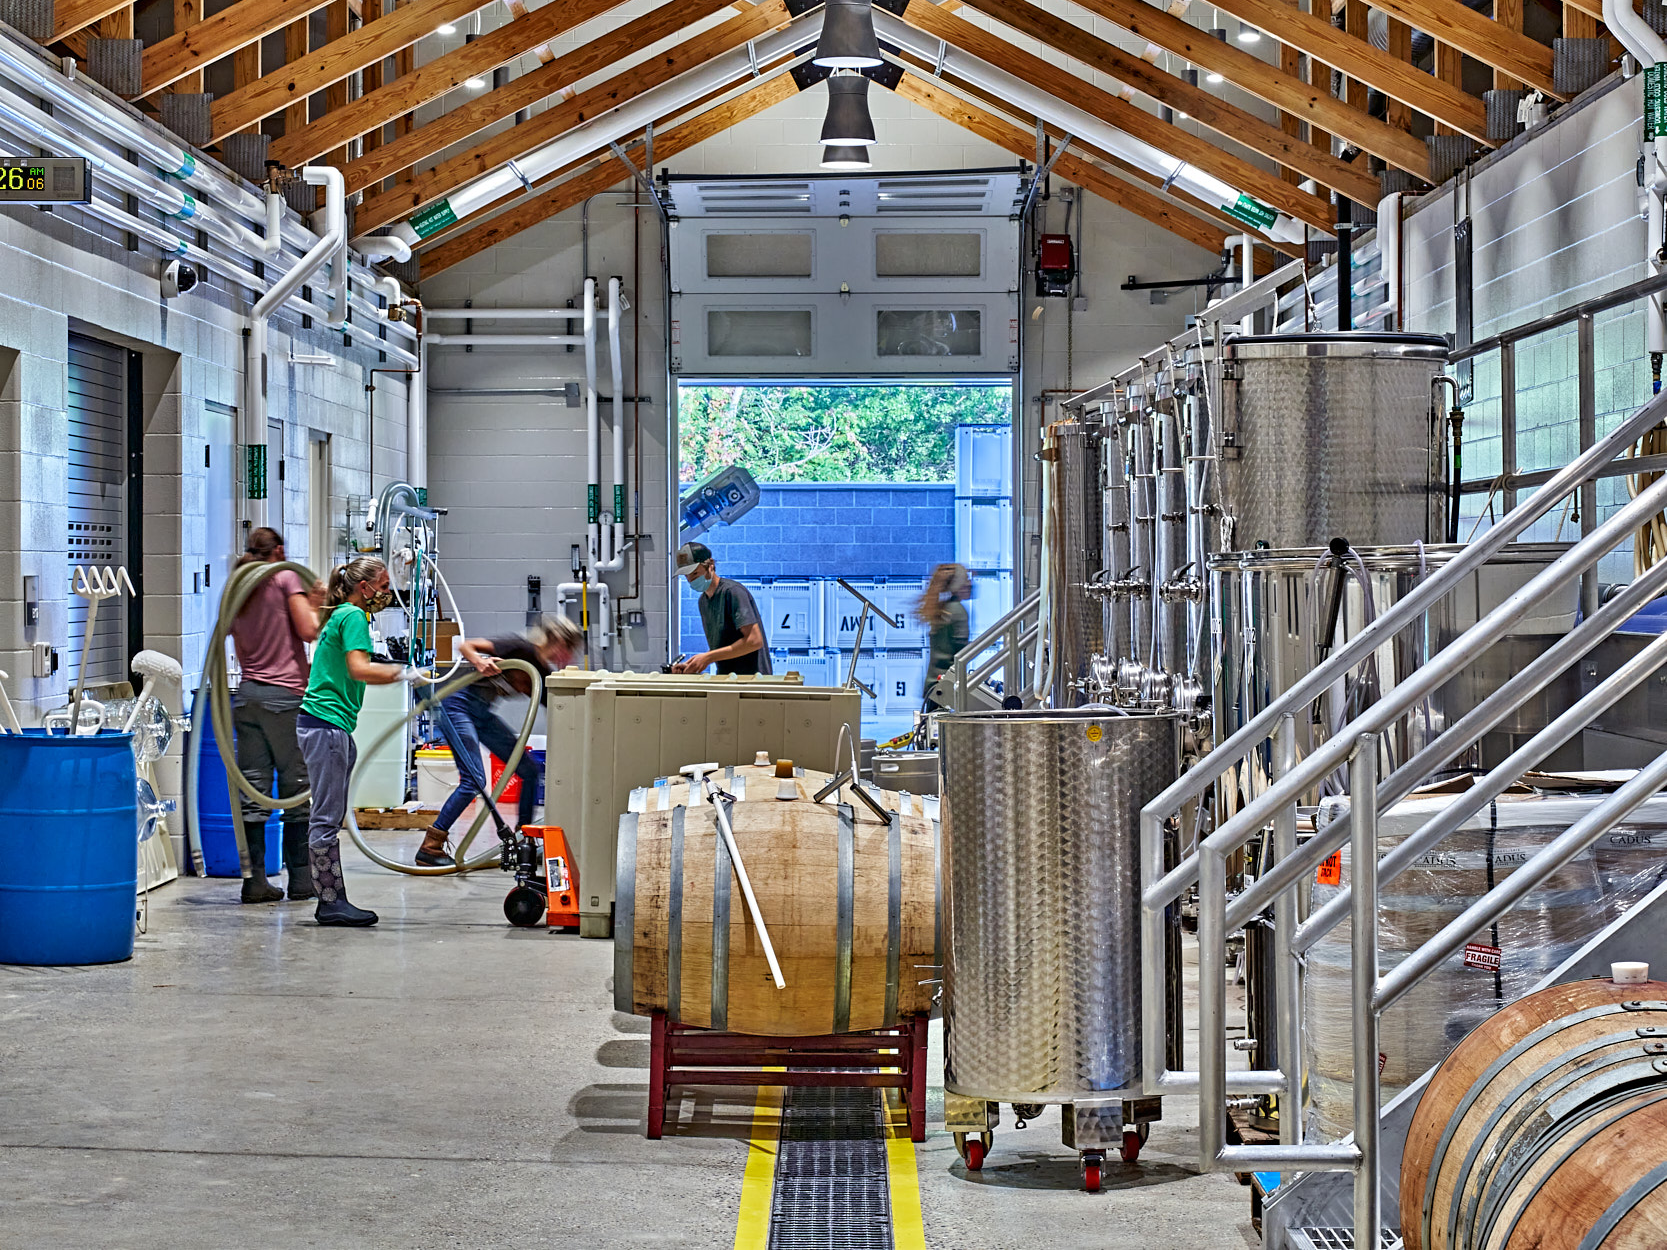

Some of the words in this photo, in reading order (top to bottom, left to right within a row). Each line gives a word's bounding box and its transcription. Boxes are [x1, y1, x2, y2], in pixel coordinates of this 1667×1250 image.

[29, 167, 44, 176] AM
[26, 177, 44, 190] 06
[1609, 835, 1651, 845] CADUS
[1494, 853, 1527, 863] ADUS
[1465, 952, 1500, 965] FRAGILE
